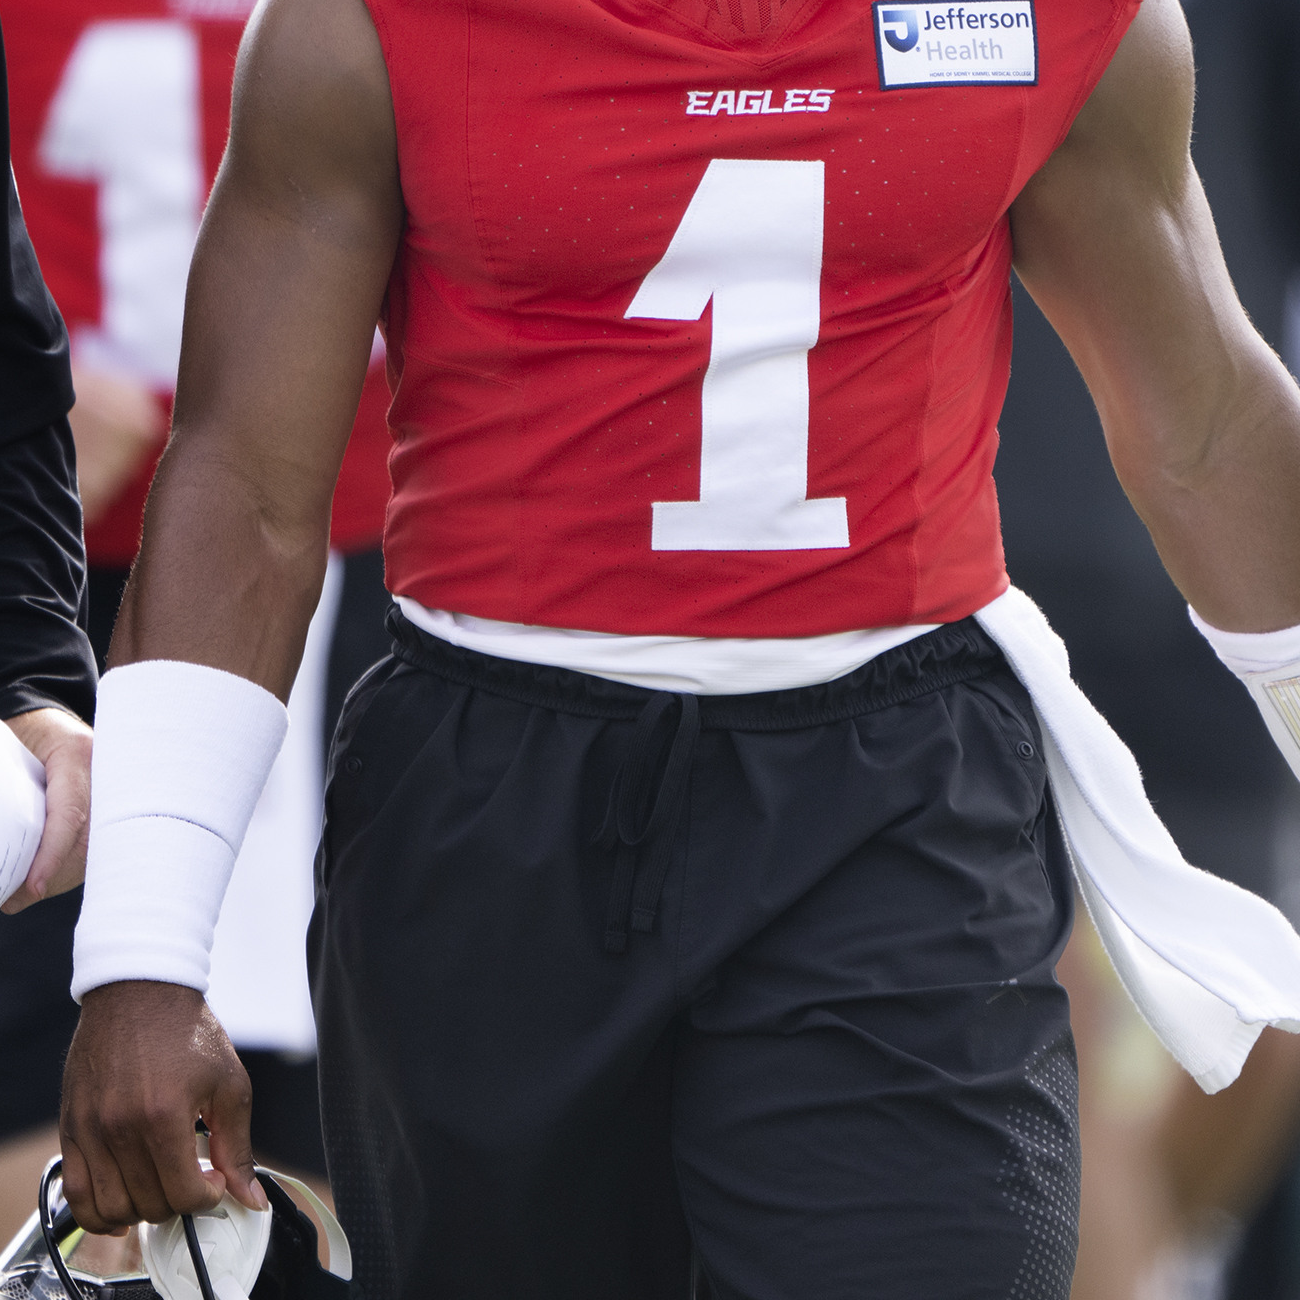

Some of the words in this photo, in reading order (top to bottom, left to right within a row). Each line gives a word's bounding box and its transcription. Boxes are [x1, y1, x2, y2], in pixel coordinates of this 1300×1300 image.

[924, 8, 1030, 31] Jefferson
[925, 38, 1003, 61] Health
[685, 89, 836, 116] EAGLES
[623, 158, 851, 551] 1
